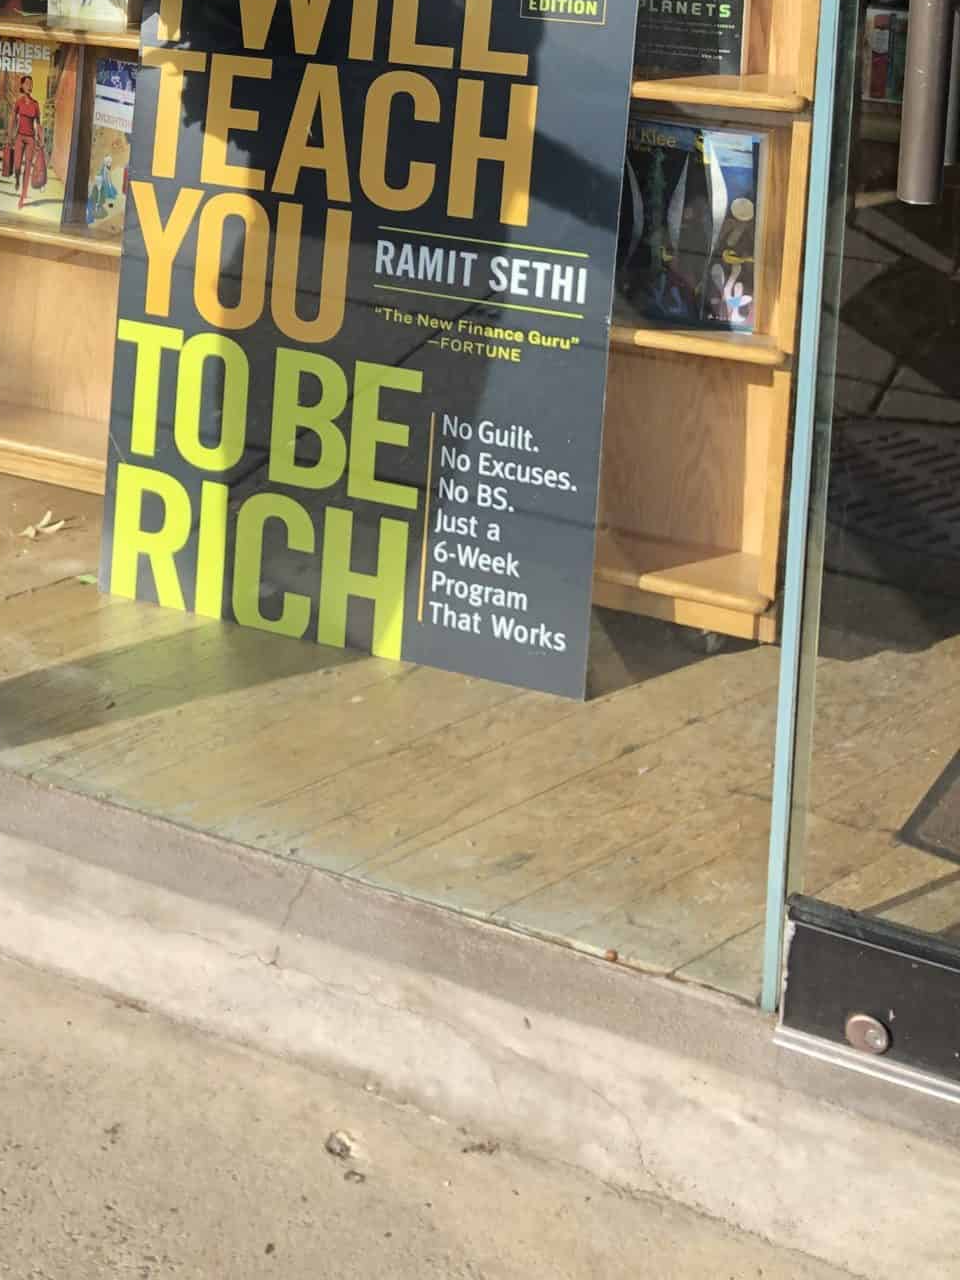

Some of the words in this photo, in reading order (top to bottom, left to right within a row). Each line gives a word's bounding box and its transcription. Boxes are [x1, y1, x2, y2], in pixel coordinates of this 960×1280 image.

[140, 46, 539, 228] TEACH
[130, 180, 353, 345] YOU
[374, 239, 478, 288] RAMIT
[488, 255, 589, 305] SETHI
[415, 312, 454, 332] New
[457, 319, 524, 343] Finance
[117, 318, 250, 472] TO
[268, 346, 424, 511] BE
[442, 413, 473, 441] No
[478, 420, 540, 453] Guilt.
[440, 444, 472, 472] No
[478, 451, 578, 493] Excuses.
[438, 476, 469, 504] No
[476, 482, 515, 513] BS.
[434, 507, 478, 538] Just
[486, 521, 501, 543] a
[109, 462, 410, 662] RICH
[433, 540, 521, 578] 6-Week
[431, 570, 529, 612] Program
[429, 601, 482, 635] That
[491, 613, 567, 652] Works
